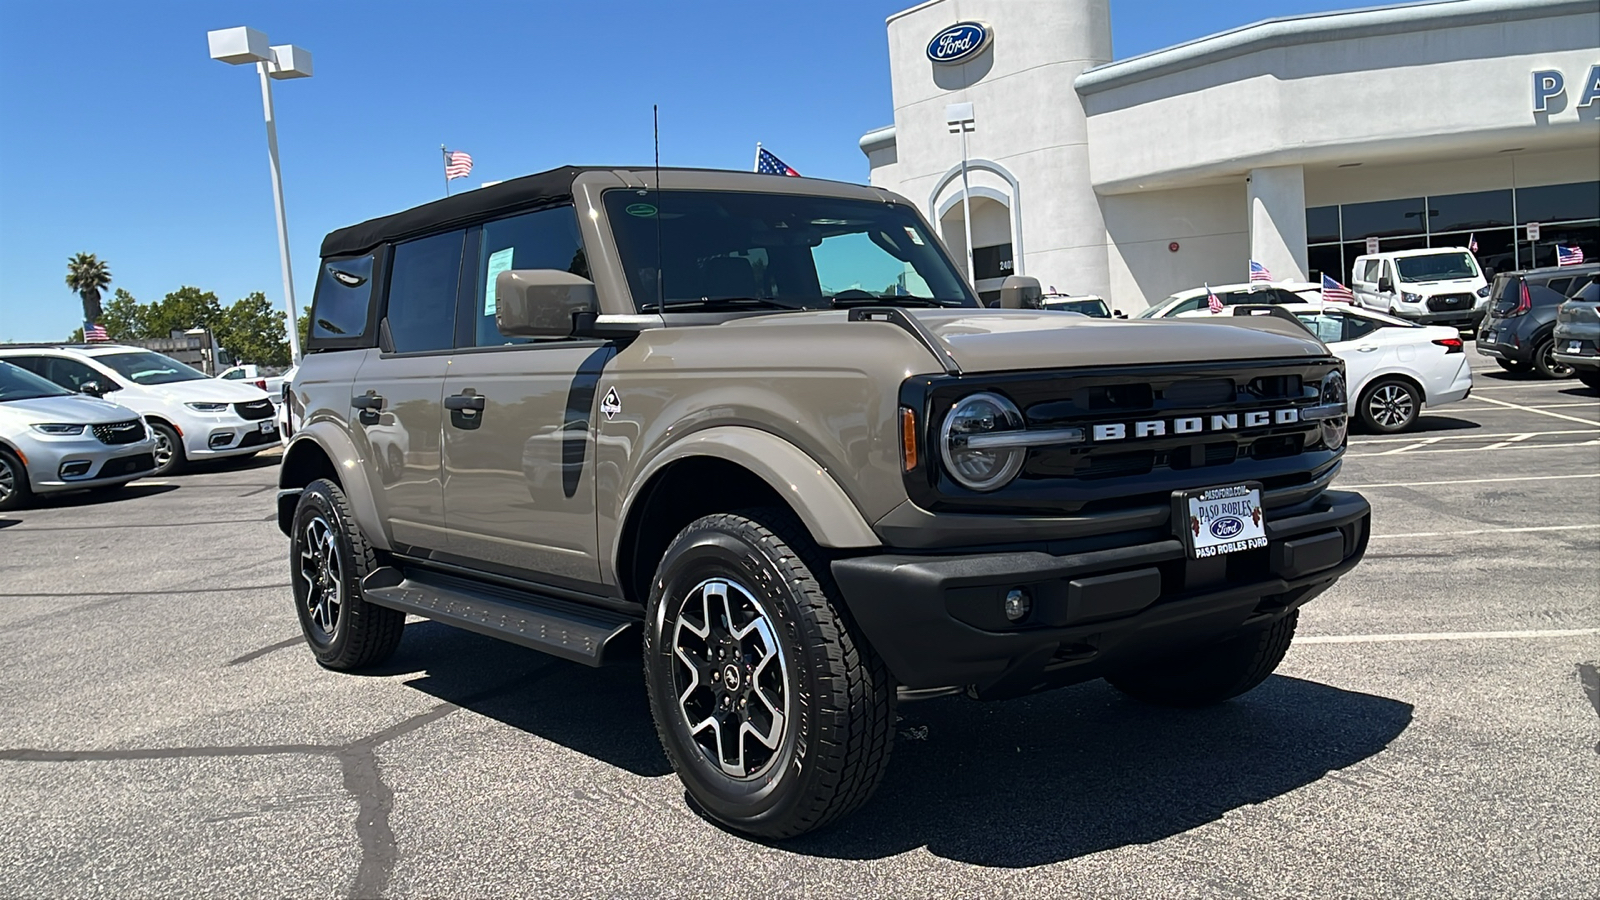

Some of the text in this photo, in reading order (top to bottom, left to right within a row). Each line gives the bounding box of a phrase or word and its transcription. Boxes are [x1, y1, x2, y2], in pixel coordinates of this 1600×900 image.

[937, 29, 972, 58] Ford
[1092, 408, 1299, 442] BRONCO
[1204, 485, 1246, 500] PASOFORD.COM
[1199, 500, 1252, 525] PASO ROBLES
[1216, 519, 1238, 536] Ford
[1195, 537, 1268, 558] PASO ROBLES FORD
